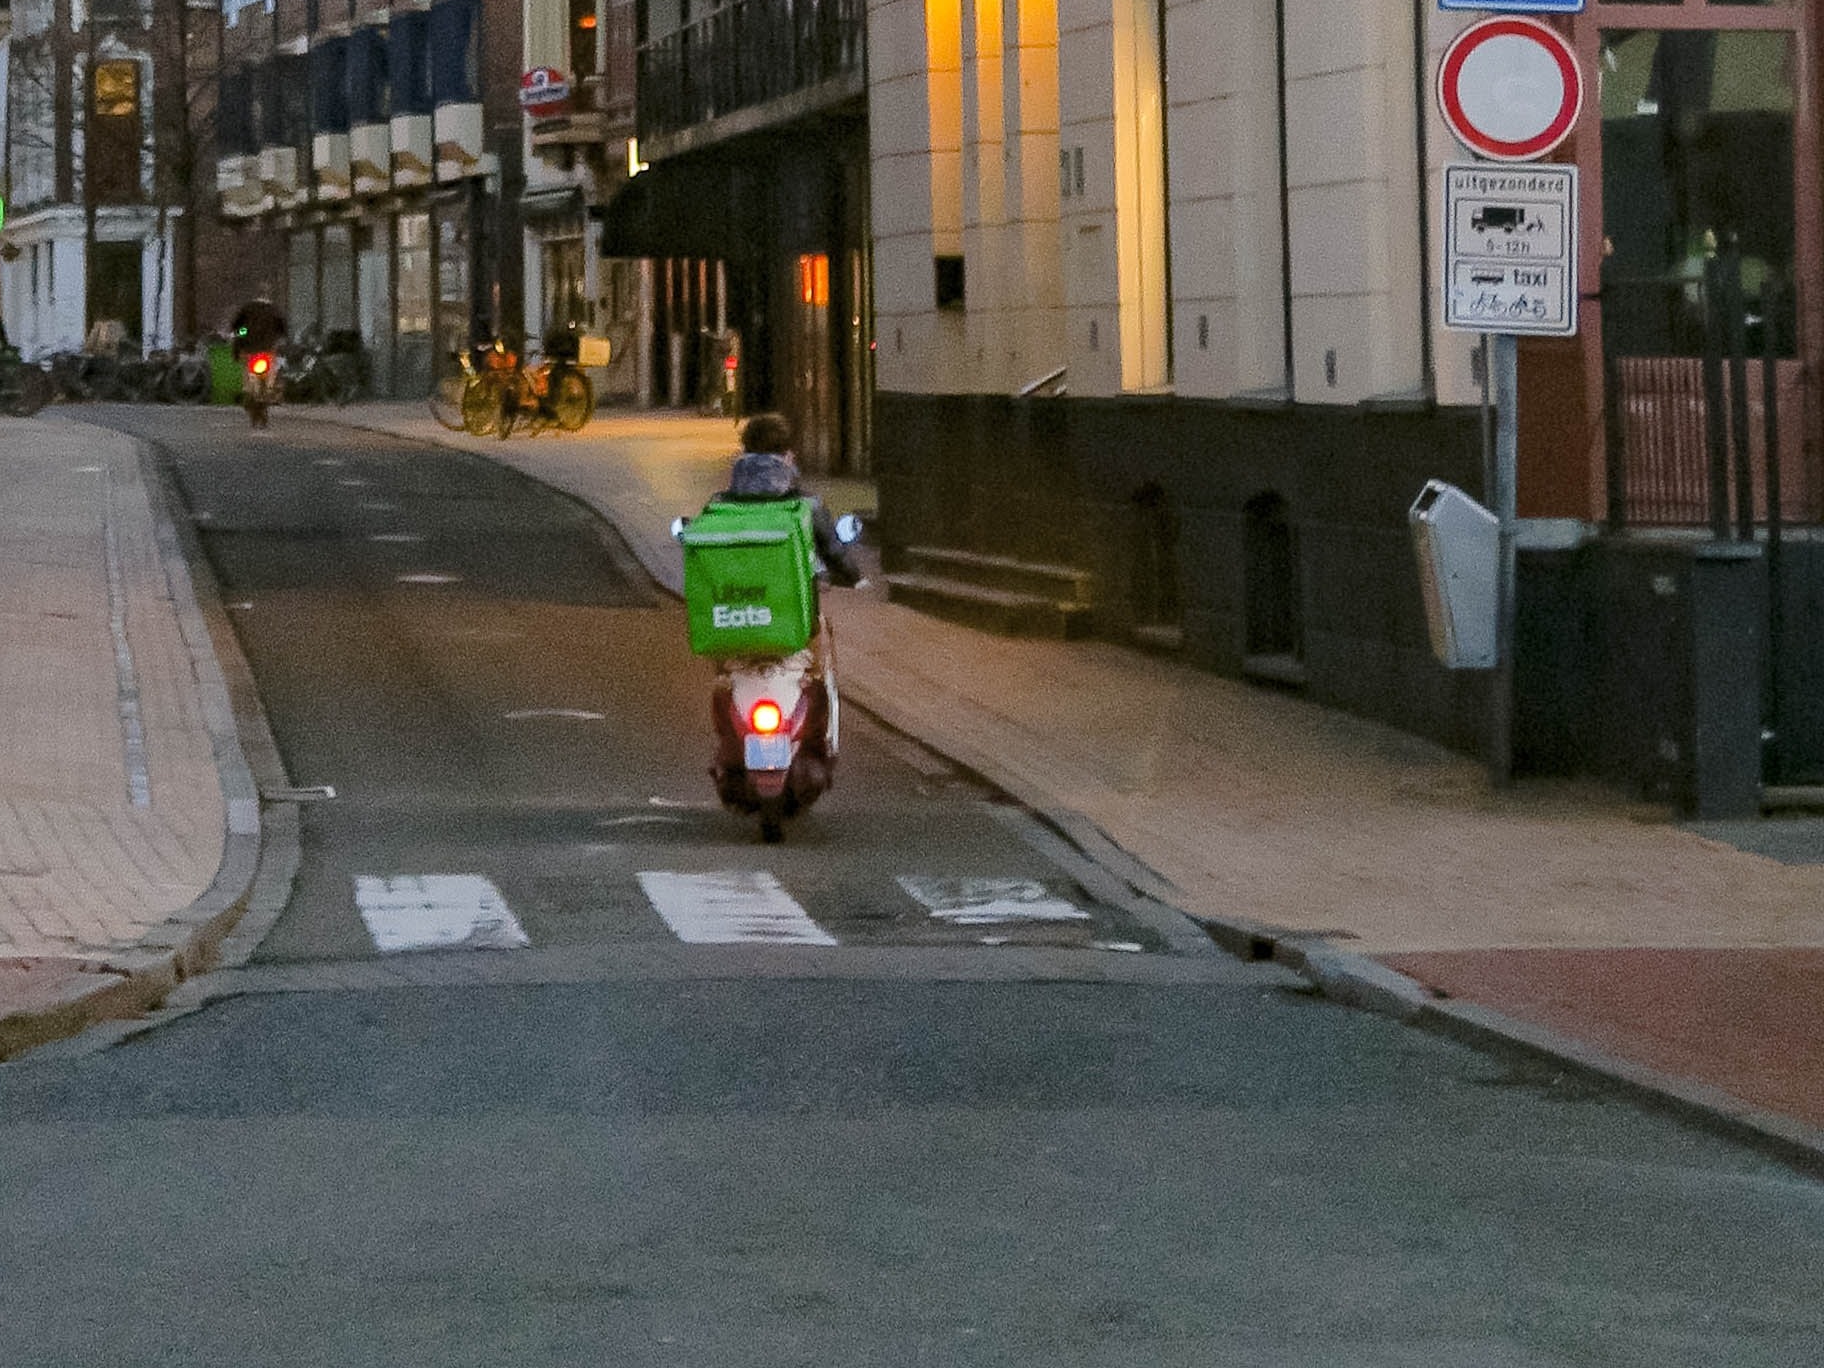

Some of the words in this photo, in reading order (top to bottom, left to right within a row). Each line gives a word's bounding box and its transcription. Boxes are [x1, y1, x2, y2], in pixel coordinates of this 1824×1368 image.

[1455, 177, 1564, 194] uitgezonderd
[1514, 269, 1547, 288] taxi
[712, 605, 772, 628] Eats
